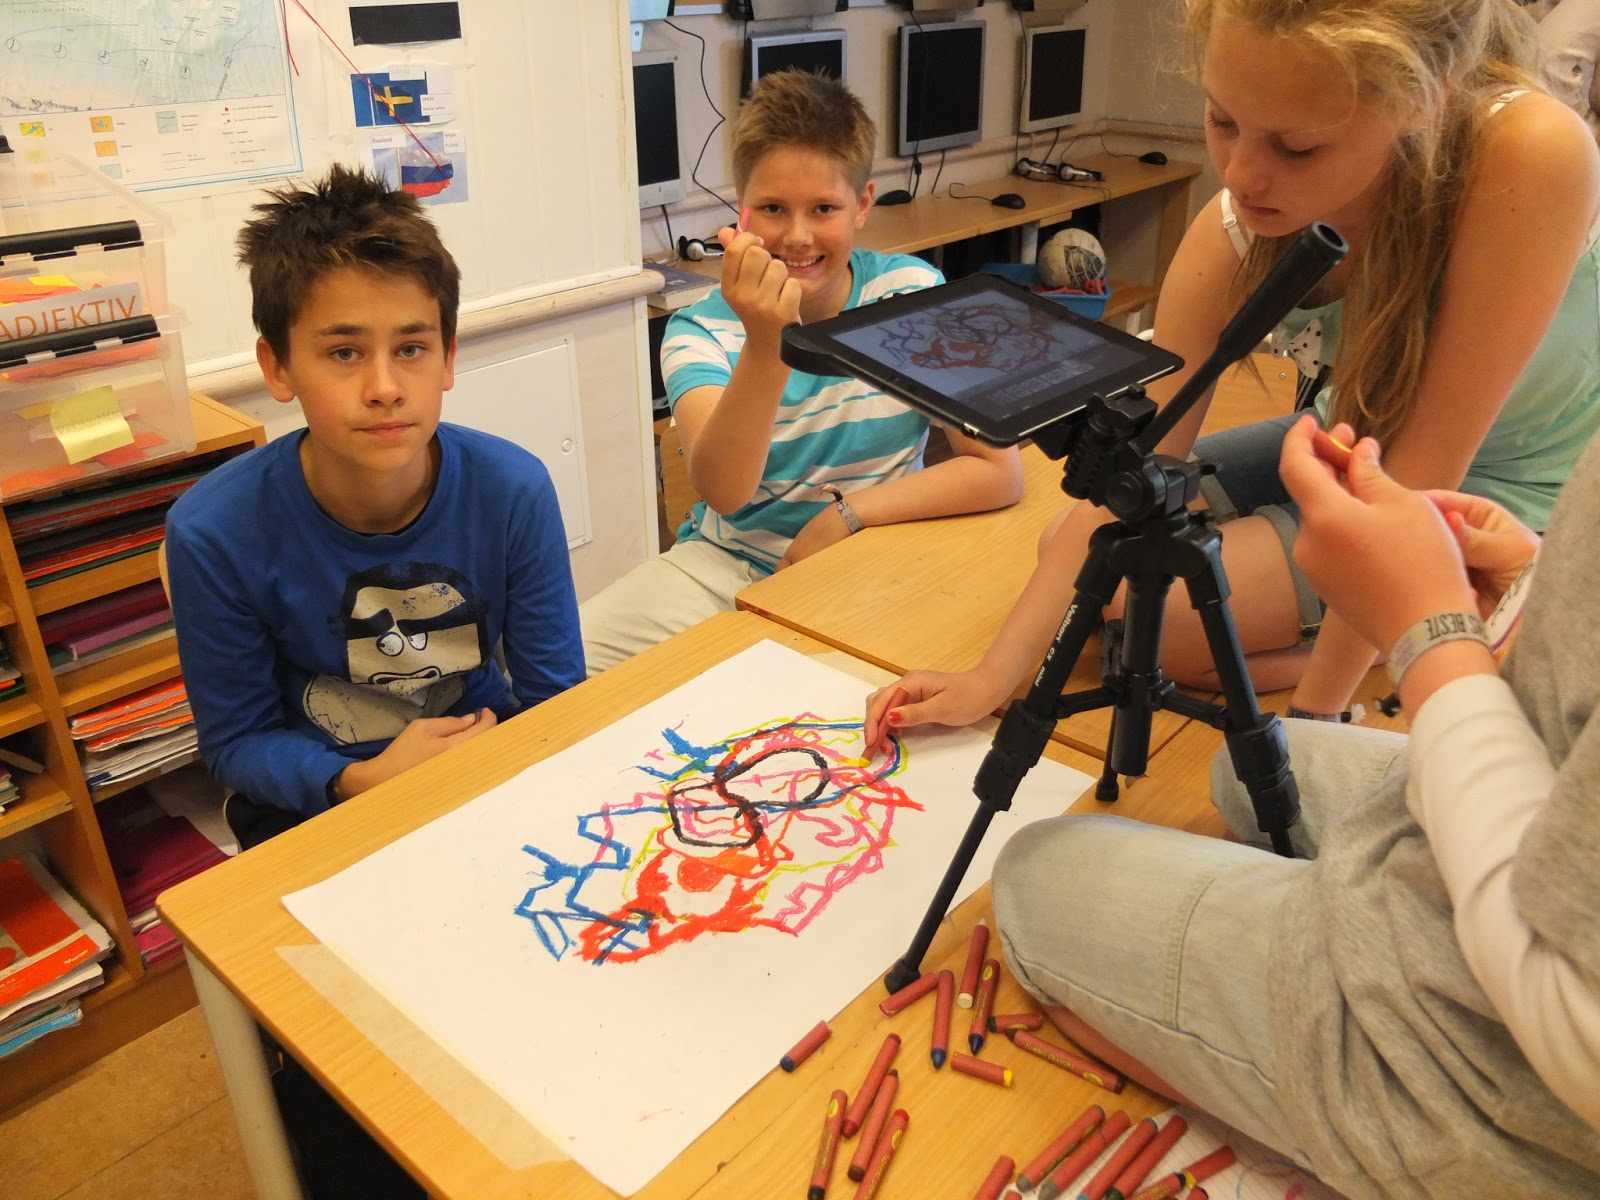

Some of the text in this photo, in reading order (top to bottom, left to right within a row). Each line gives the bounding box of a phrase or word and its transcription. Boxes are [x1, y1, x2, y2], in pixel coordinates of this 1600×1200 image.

[0, 295, 137, 341] ADJEKTIV
[1056, 604, 1078, 642] Velbon
[1424, 613, 1467, 641] BESTE
[1034, 665, 1046, 687] mini
